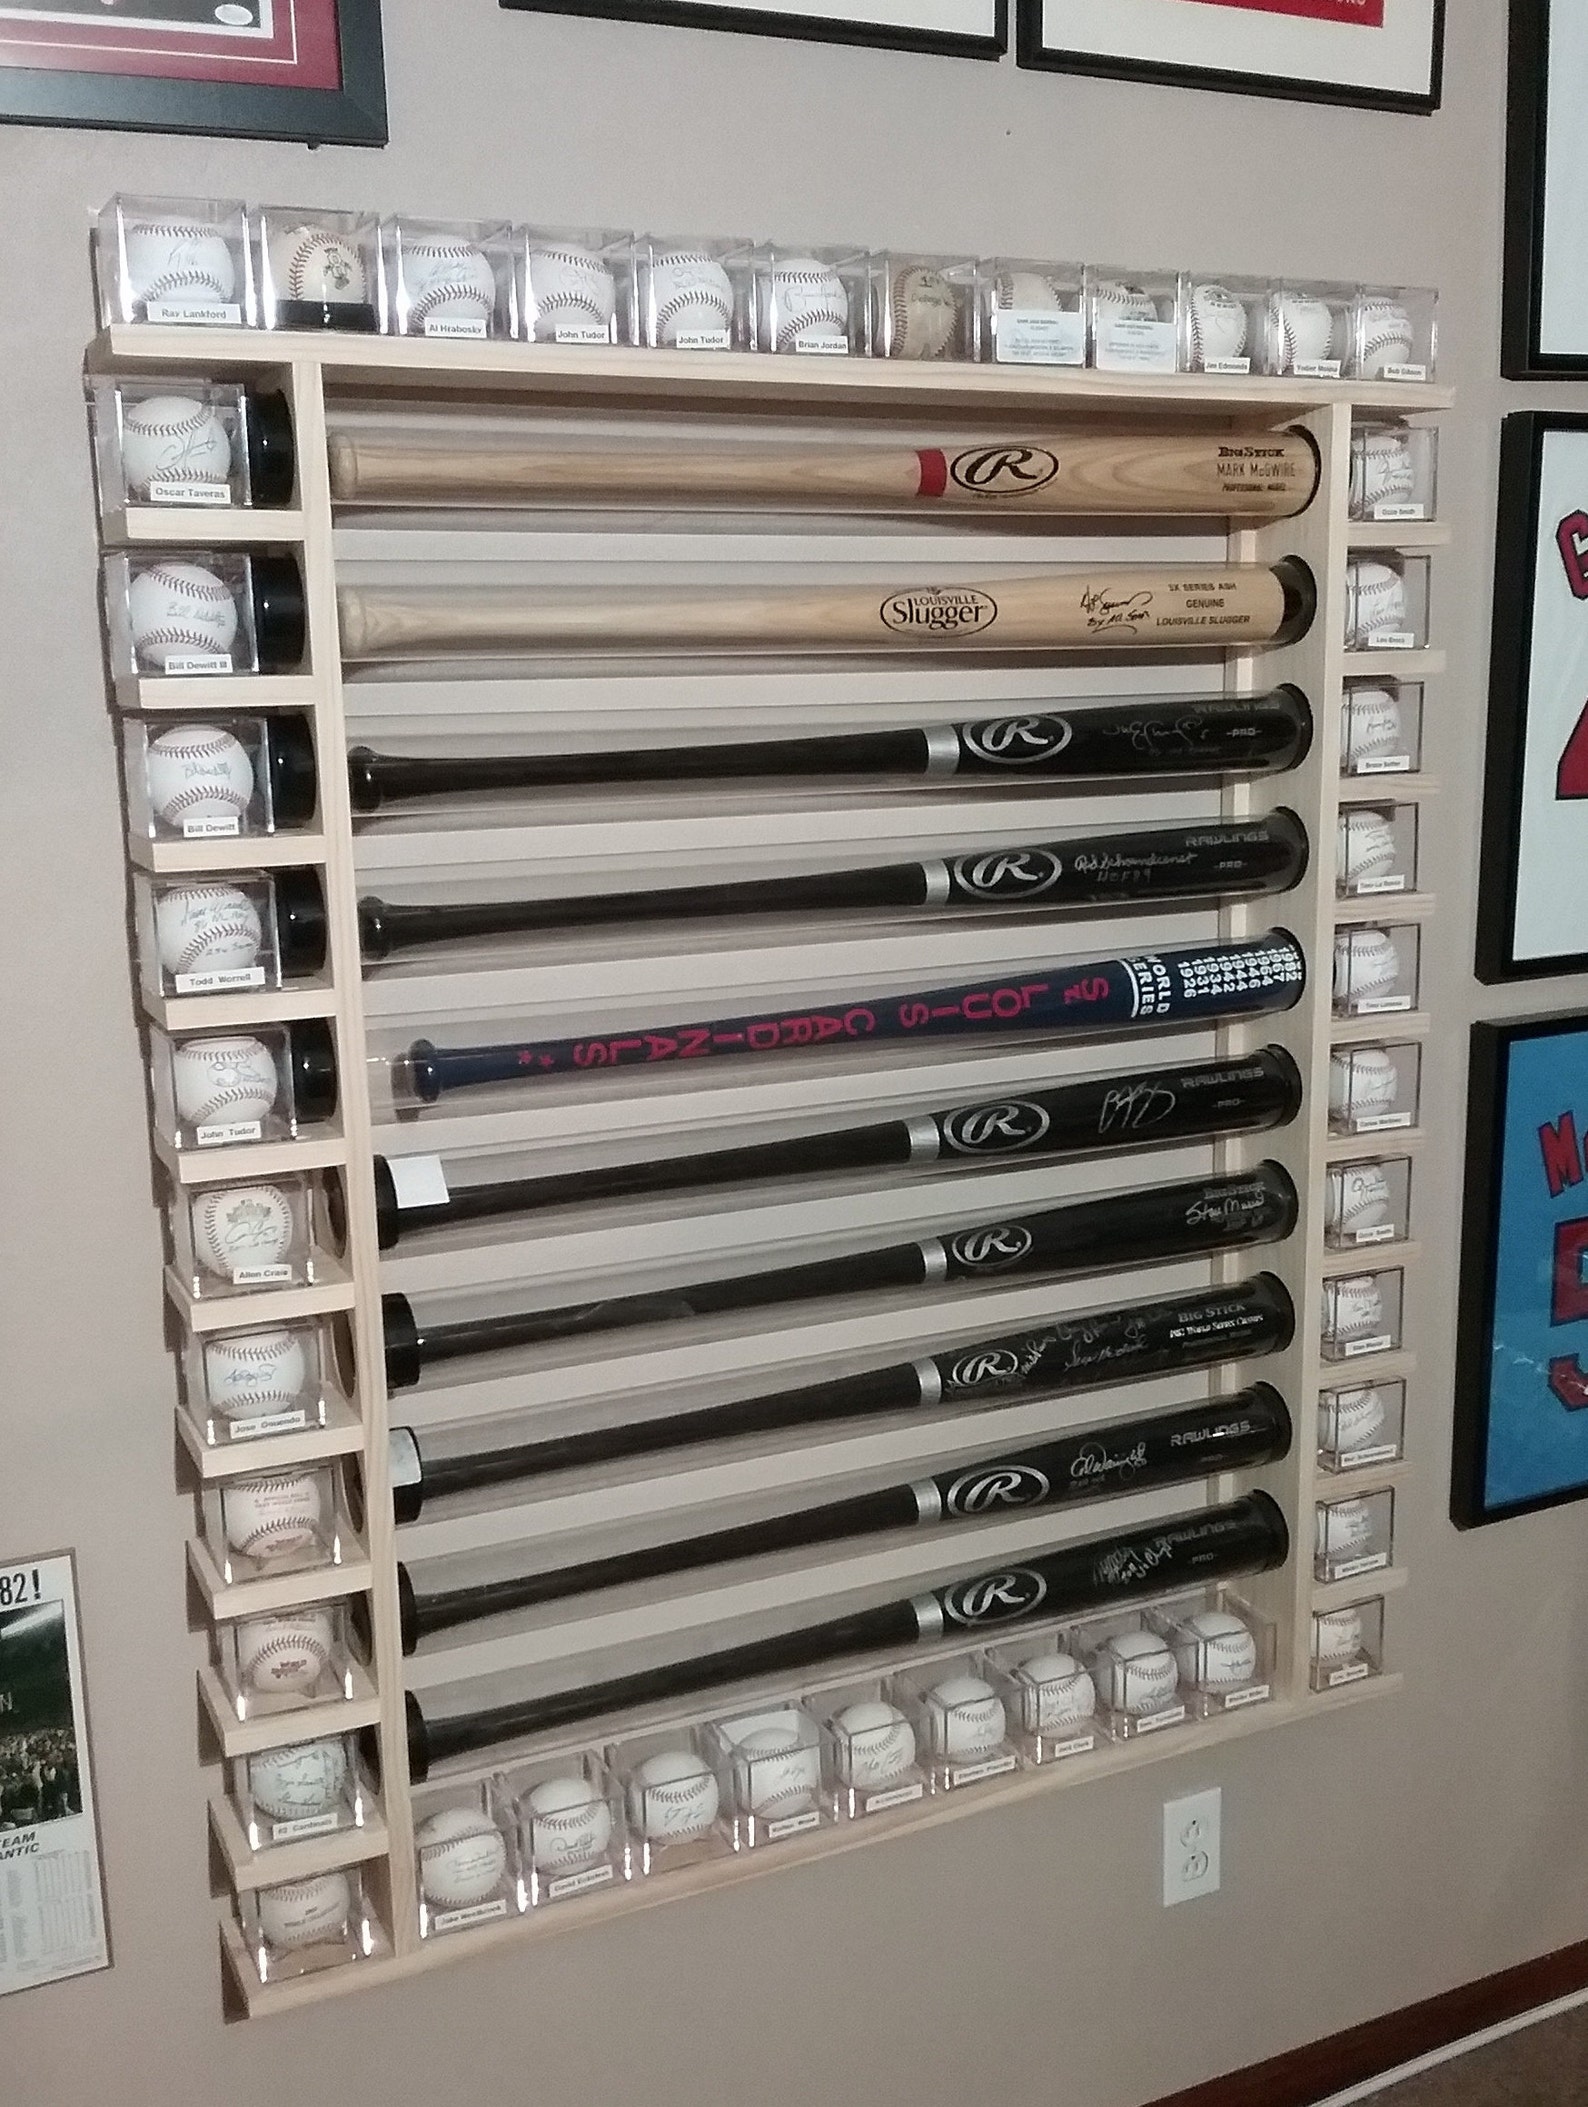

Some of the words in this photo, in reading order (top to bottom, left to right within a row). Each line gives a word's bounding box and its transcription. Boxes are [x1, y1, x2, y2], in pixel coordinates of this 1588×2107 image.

[162, 307, 179, 320] Ray
[182, 308, 227, 320] Lankford
[440, 325, 484, 335] Hrabosky
[558, 330, 578, 340] John
[580, 330, 606, 340] Tudor
[678, 335, 698, 345] John
[700, 335, 724, 345] Tudor
[798, 340, 819, 350] Brian
[820, 341, 848, 351] Jordan
[1217, 463, 1245, 478] MARK
[156, 487, 185, 496] Oscar
[187, 489, 226, 499] Taveras
[914, 594, 979, 606] LOUISVILLE
[1186, 599, 1226, 608] GENUINE
[892, 598, 984, 630] Slugger
[1156, 616, 1207, 626] LOUISVILLE
[1208, 615, 1251, 625] SLUGGER
[168, 660, 185, 670] Bill
[187, 823, 204, 834] Bill
[1230, 954, 1248, 992] 1944
[1242, 952, 1262, 989] 1946
[1254, 950, 1274, 986] 1964
[1266, 948, 1285, 982] 1967
[1278, 947, 1298, 982] 1982
[190, 976, 214, 986] Todd
[1178, 961, 1196, 998] 1926
[1192, 959, 1210, 995] 1931
[1203, 956, 1222, 996] 1934
[1216, 955, 1236, 992] 1942
[900, 983, 1049, 1029] LOUIS
[573, 1007, 876, 1067] CARDINALS
[1180, 1066, 1265, 1088] RAWLINGS
[200, 1129, 224, 1140] John
[228, 1126, 256, 1136] Tudor
[1178, 1312, 1203, 1323] BIG
[1205, 1303, 1246, 1318] STICK
[0, 1831, 36, 1848] EAM
